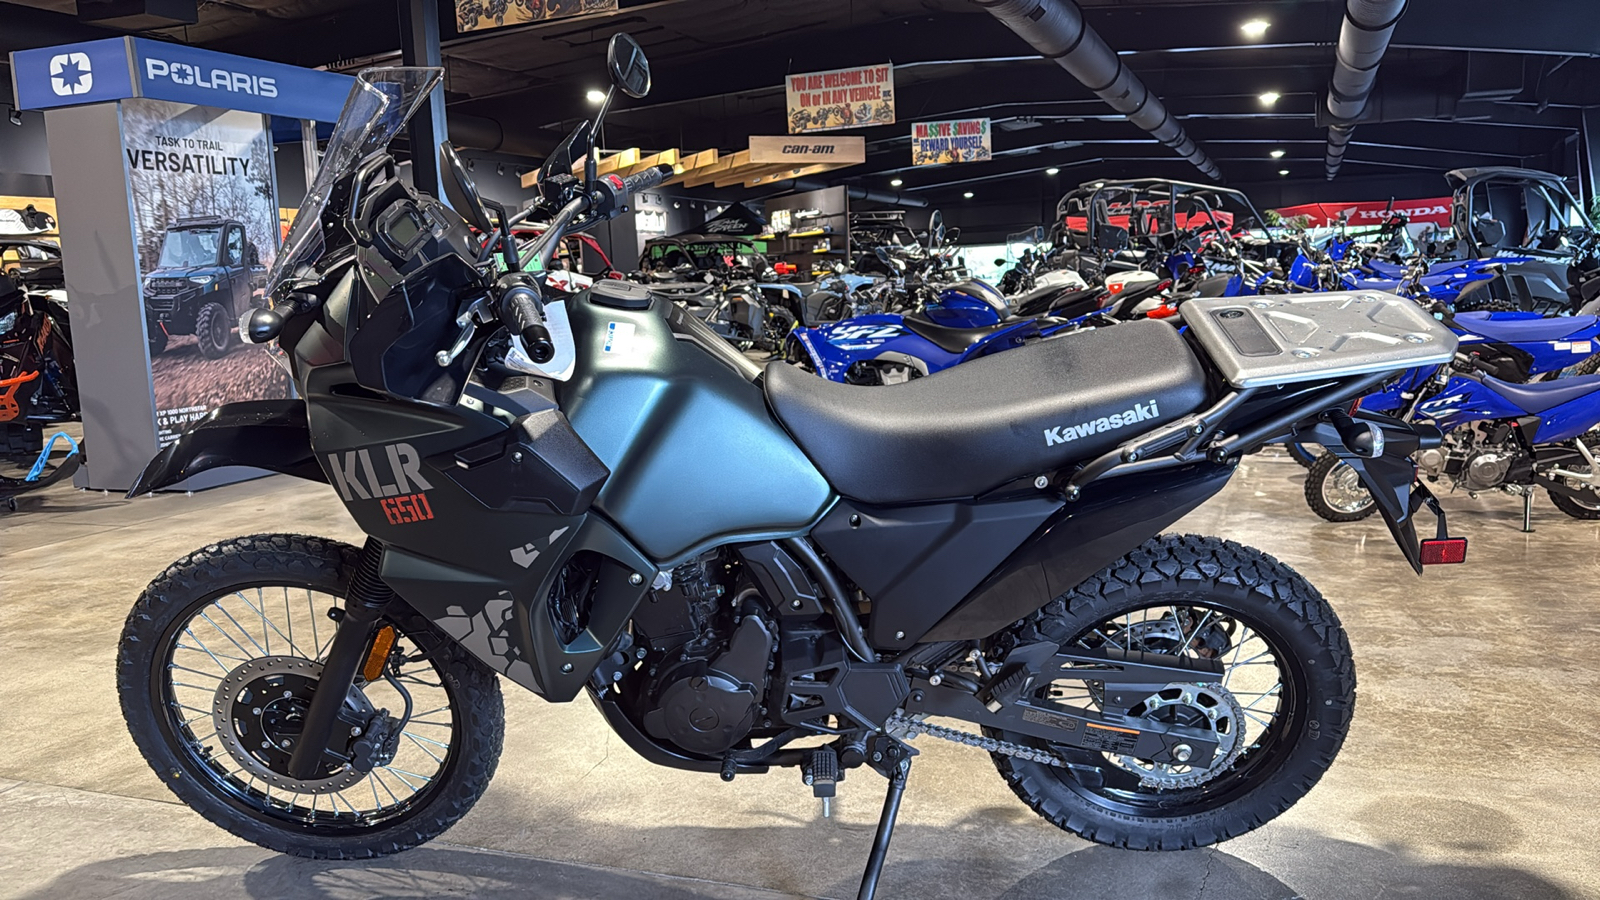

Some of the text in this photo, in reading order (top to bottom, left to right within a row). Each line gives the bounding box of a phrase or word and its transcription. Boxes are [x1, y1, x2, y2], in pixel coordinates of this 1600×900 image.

[145, 58, 279, 98] POLARIS
[791, 67, 889, 92] YOU ARE WELCOME TO SIT
[800, 93, 811, 107] ON
[822, 90, 831, 105] IN
[832, 88, 848, 104] ANY
[849, 85, 881, 102] VEHICLE
[155, 136, 223, 151] TASK TO TRAIL
[782, 144, 836, 154] can-am
[921, 137, 949, 152] REWARD
[950, 135, 982, 150] YOURSELF
[126, 148, 250, 177] VERSATILITY
[170, 414, 188, 424] PLAY
[1044, 399, 1160, 446] Kawasaki
[327, 442, 434, 501] KLR
[380, 493, 434, 525] 650
